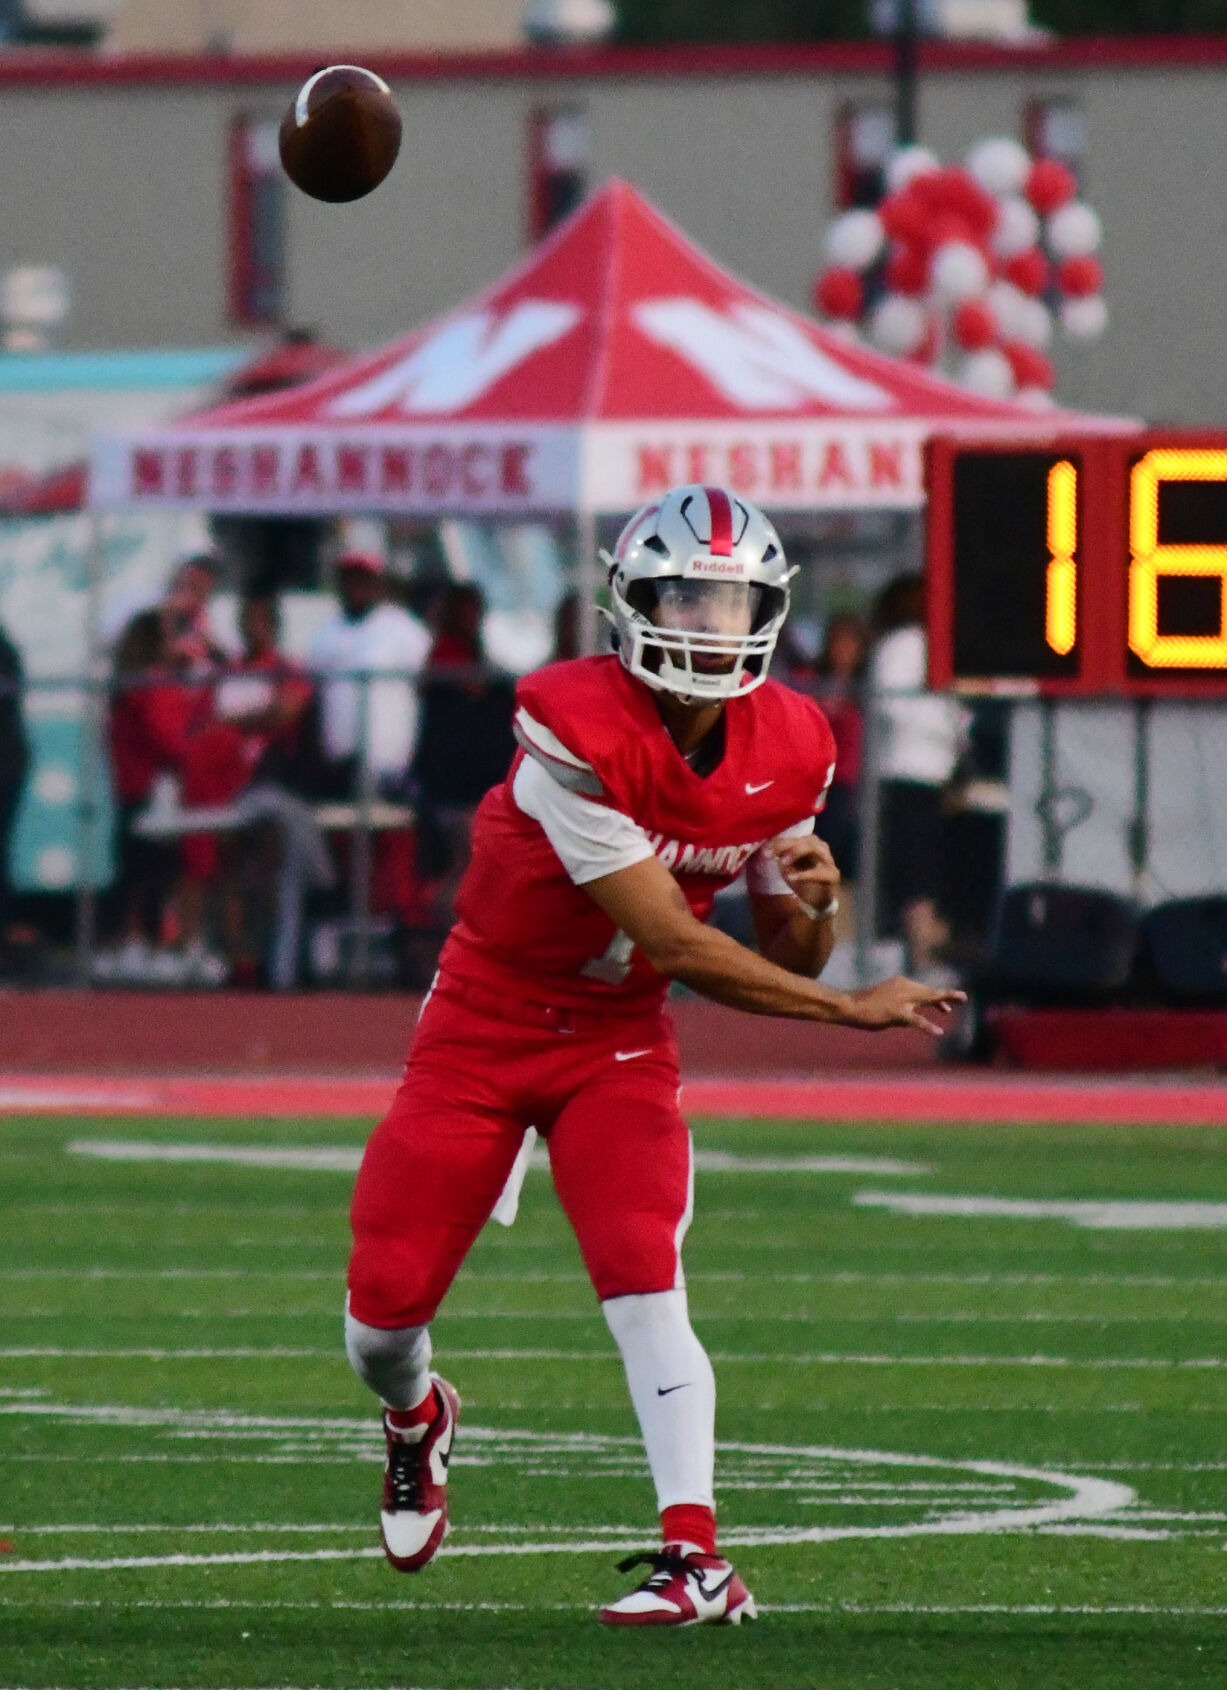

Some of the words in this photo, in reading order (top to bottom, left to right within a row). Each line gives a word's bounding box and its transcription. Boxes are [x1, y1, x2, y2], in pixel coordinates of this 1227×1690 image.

[132, 441, 533, 498] NESHANNOCK
[638, 442, 902, 491] NESHAN
[692, 559, 744, 575] Riddell
[1046, 449, 1227, 669] 16
